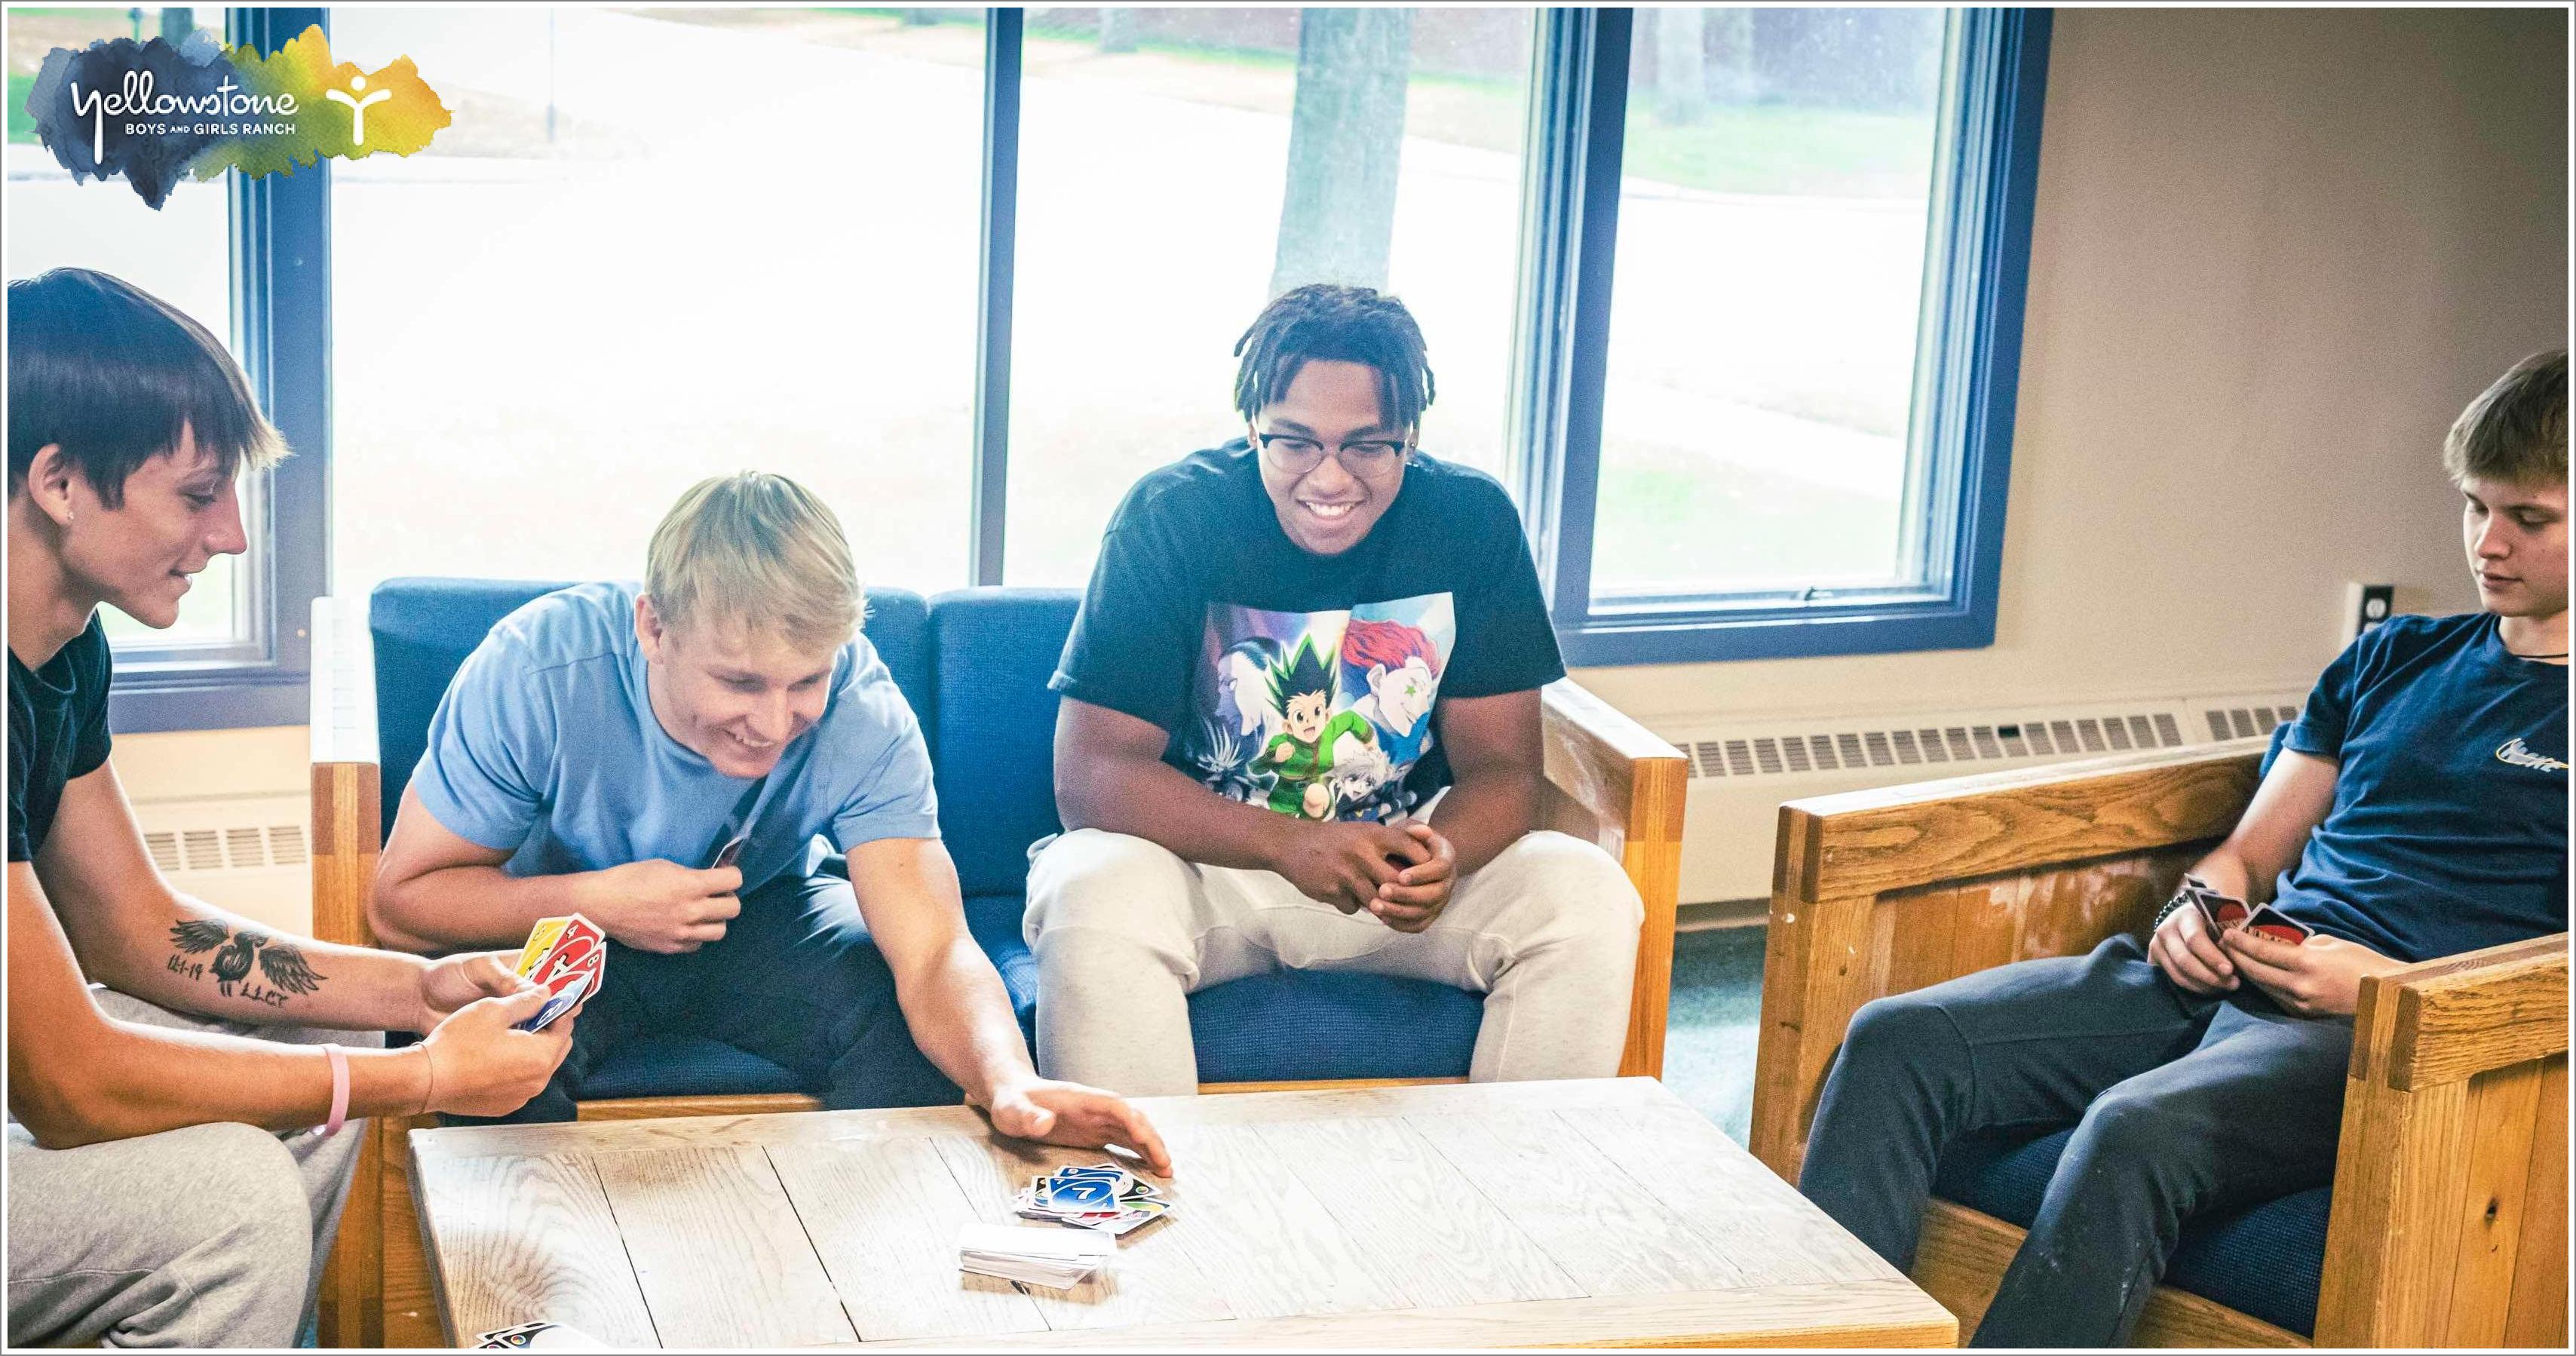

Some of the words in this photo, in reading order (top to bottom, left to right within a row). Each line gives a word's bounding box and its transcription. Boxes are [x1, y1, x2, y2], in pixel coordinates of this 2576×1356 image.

[567, 924, 579, 939] 4
[587, 953, 600, 968] 8
[1072, 1187, 1097, 1200] 7
